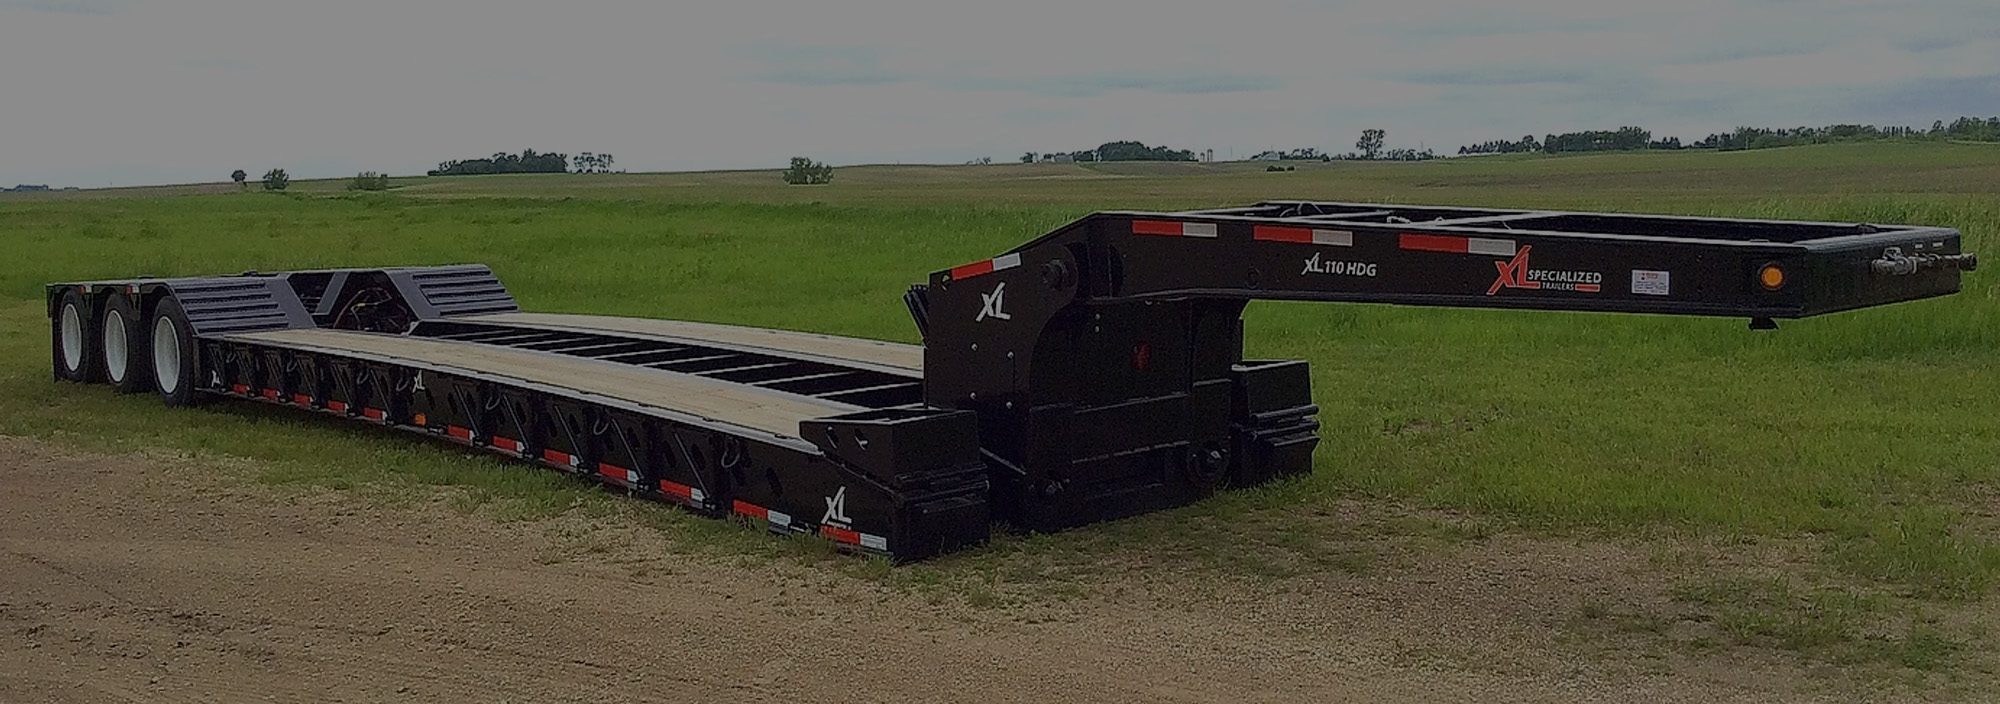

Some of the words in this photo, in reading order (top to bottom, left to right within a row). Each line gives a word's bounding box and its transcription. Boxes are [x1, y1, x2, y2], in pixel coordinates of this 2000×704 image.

[1300, 252, 1324, 275] XL
[1324, 260, 1345, 275] 110
[1345, 261, 1378, 277] HDG
[1486, 245, 1540, 295] XL
[1527, 269, 1602, 284] SPECIALIZED
[975, 281, 1011, 322] XL
[820, 485, 852, 524] XL
